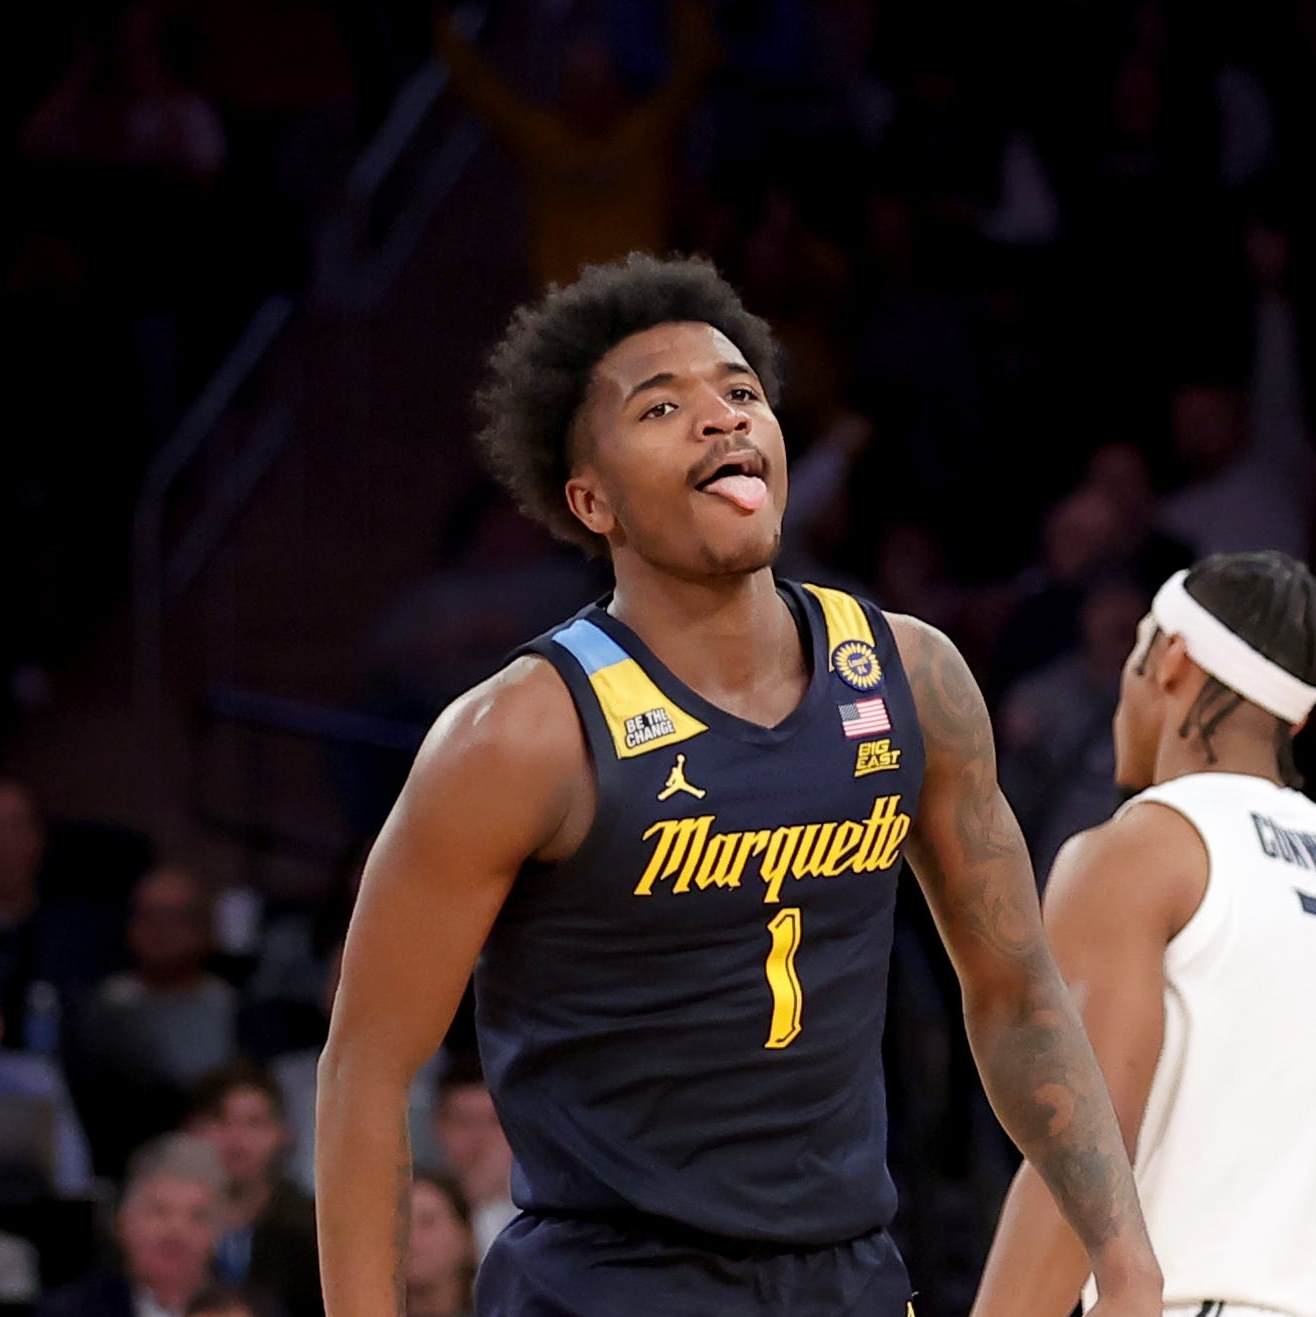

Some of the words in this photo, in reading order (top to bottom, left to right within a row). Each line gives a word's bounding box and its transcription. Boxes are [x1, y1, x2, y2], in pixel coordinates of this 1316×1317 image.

[626, 715, 645, 734] BE
[645, 708, 668, 725] THE
[626, 719, 675, 748] CHANGE
[856, 750, 901, 770] EAST
[858, 739, 890, 757] BIG
[633, 794, 911, 903] Marquette
[764, 907, 803, 1049] 1
